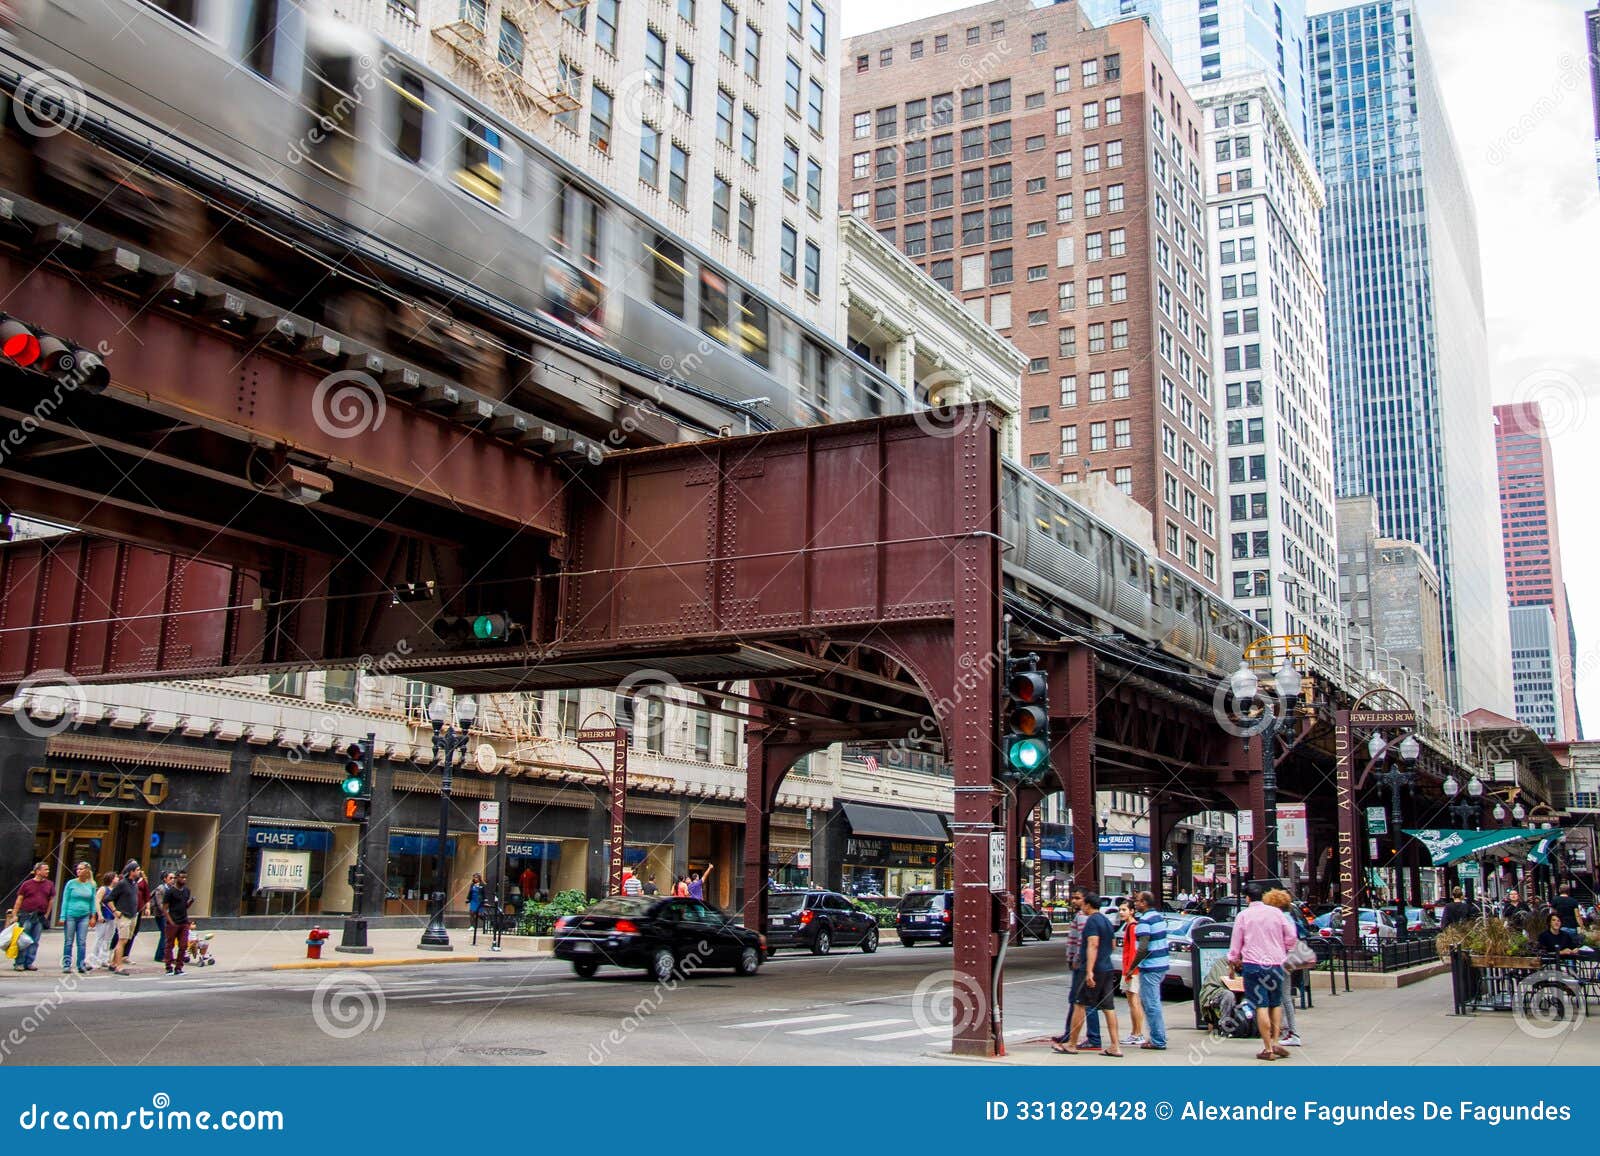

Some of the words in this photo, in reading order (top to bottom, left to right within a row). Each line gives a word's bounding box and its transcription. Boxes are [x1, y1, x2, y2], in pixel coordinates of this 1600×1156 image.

[1350, 713, 1394, 722] JEWELERS
[1395, 713, 1415, 721] ROW
[615, 739, 626, 808] AVENUE
[1335, 725, 1351, 811] AVENUE
[25, 766, 138, 801] CHASE
[255, 832, 295, 845] CHASE
[505, 844, 533, 856] CHASE
[992, 837, 1005, 851] ONE
[267, 863, 288, 877] ENJOY
[289, 864, 303, 877] LIFE
[611, 824, 623, 895] WABASH
[1338, 831, 1354, 917] WABASH
